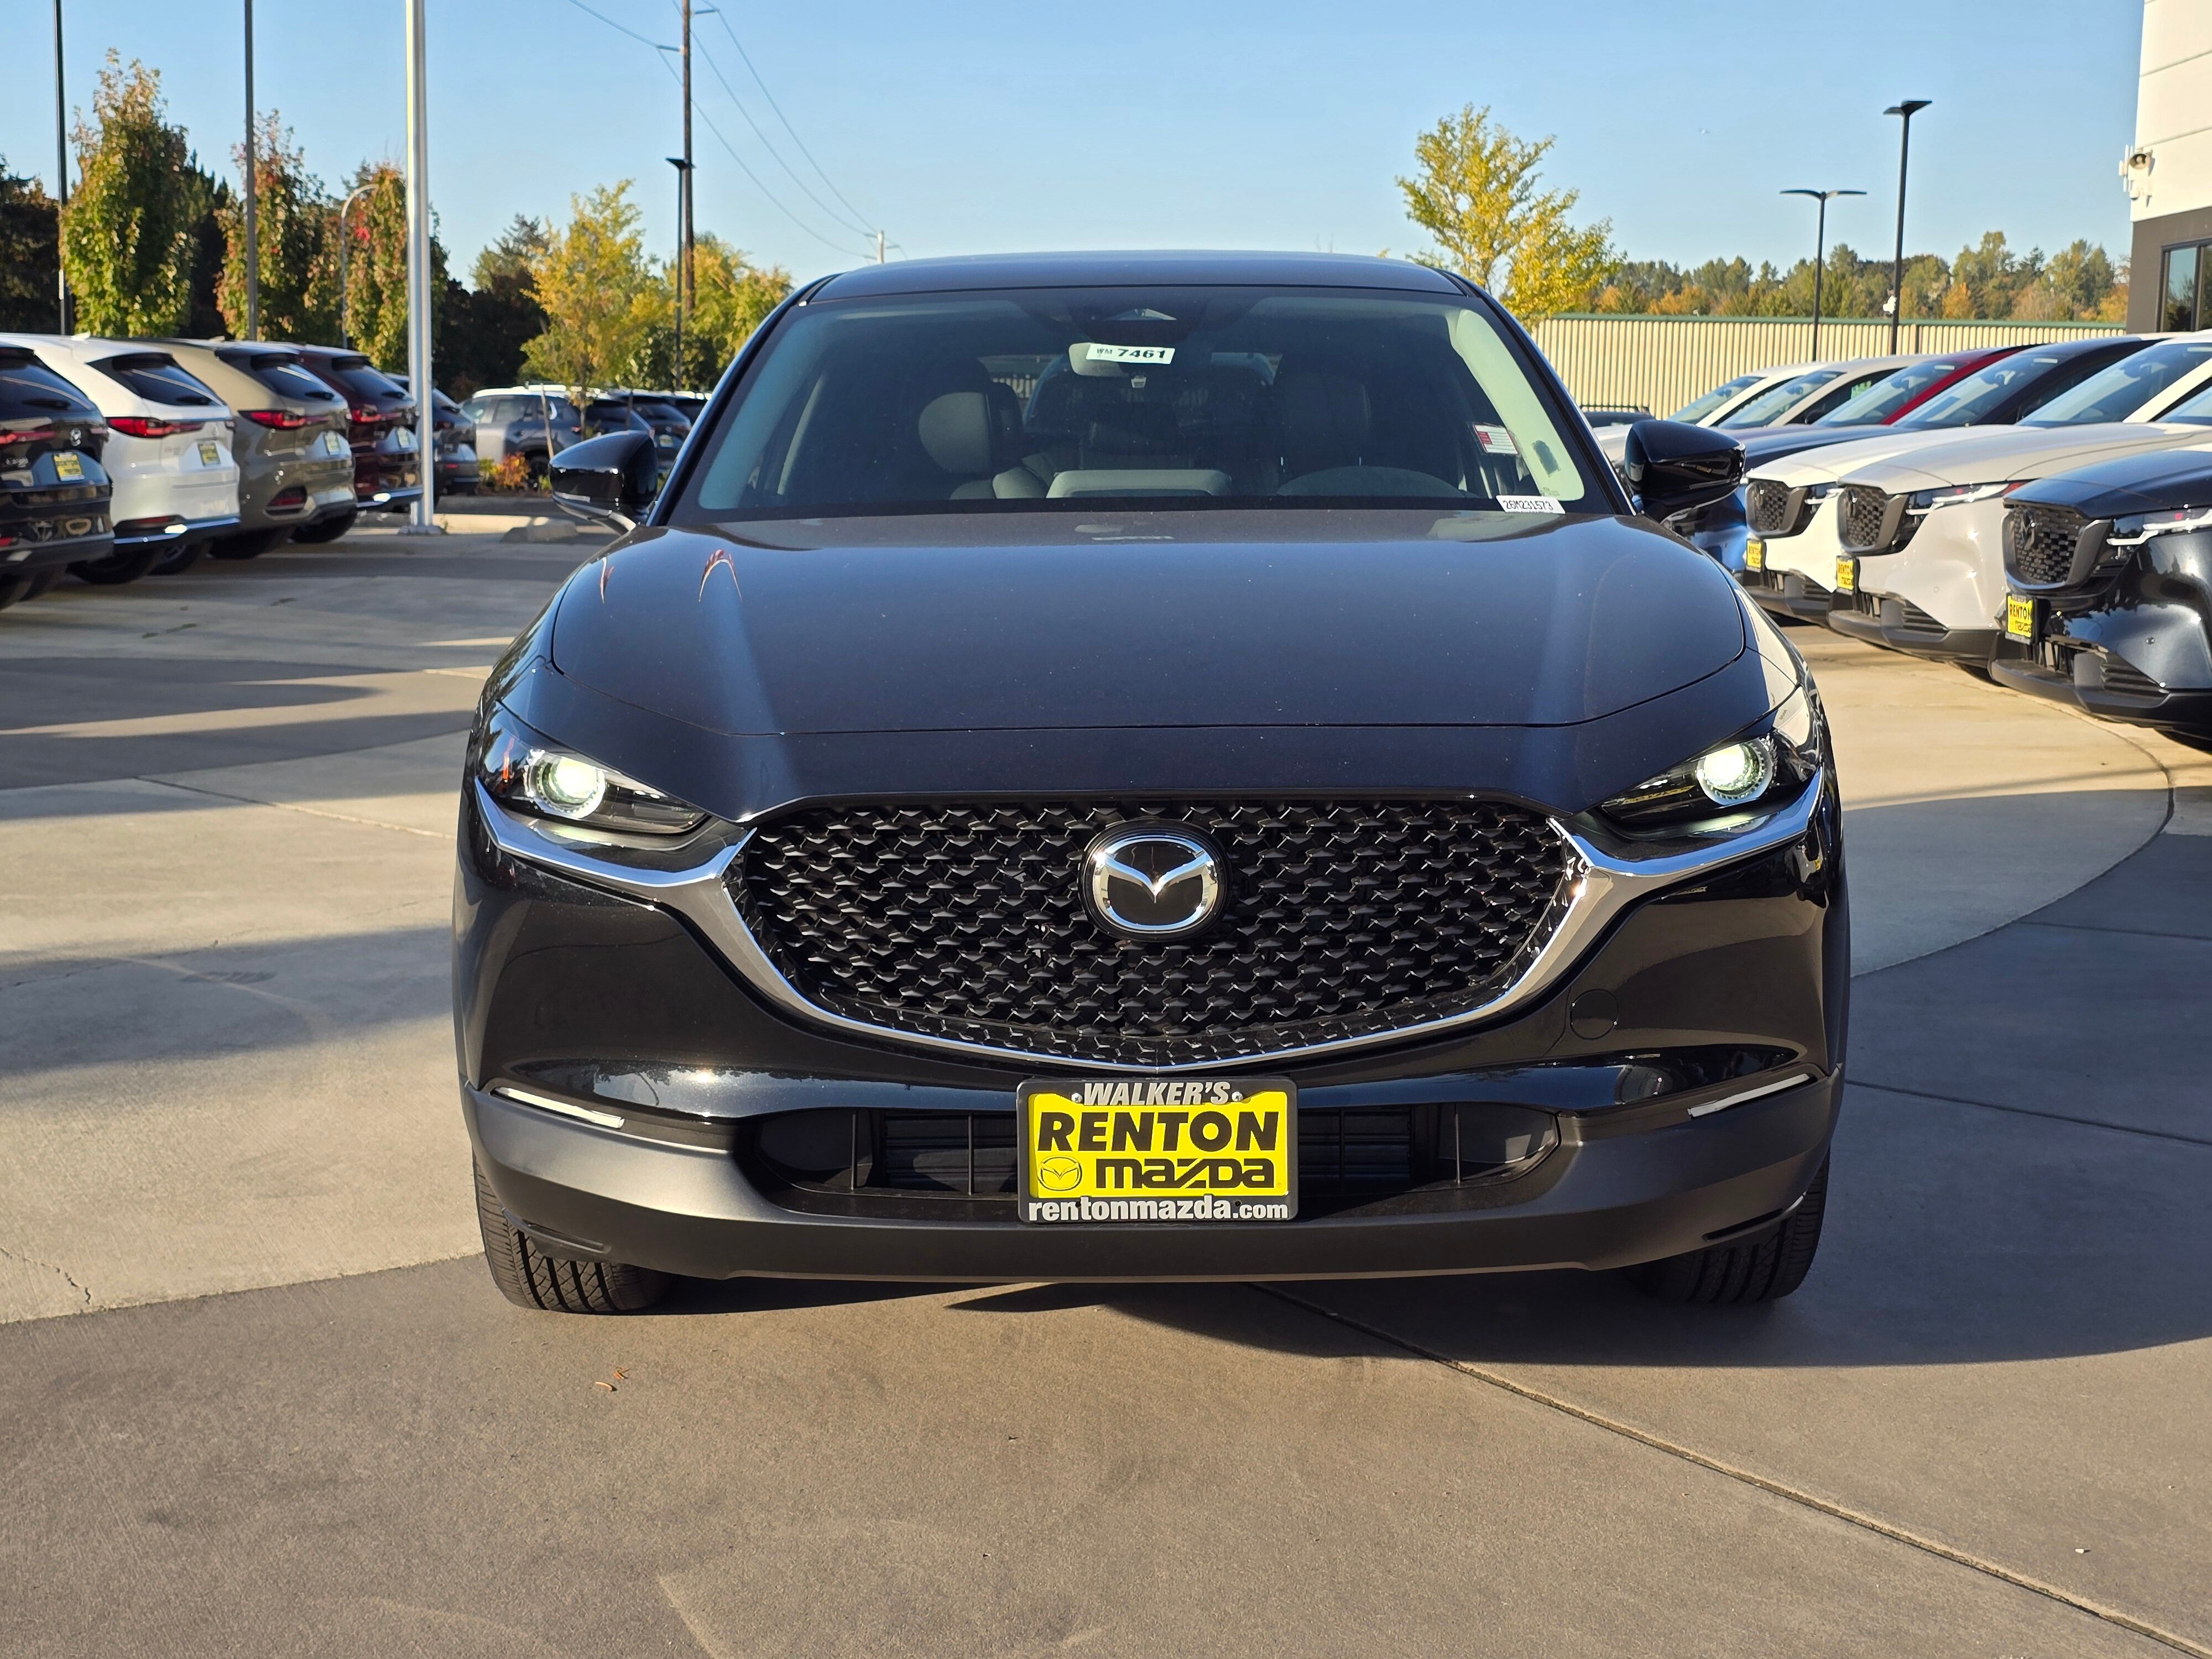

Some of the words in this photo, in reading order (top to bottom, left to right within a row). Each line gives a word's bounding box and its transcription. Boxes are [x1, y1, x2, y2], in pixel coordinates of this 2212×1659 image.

[1117, 348, 1166, 359] 7461
[1503, 499, 1554, 511] 26M231573
[2010, 604, 2033, 621] RENTON
[1084, 1082, 1231, 1105] WALKER'S
[1038, 1111, 1279, 1151] RENTON
[1095, 1157, 1275, 1189] mazda
[1028, 1195, 1288, 1220] rentonmazda.com
